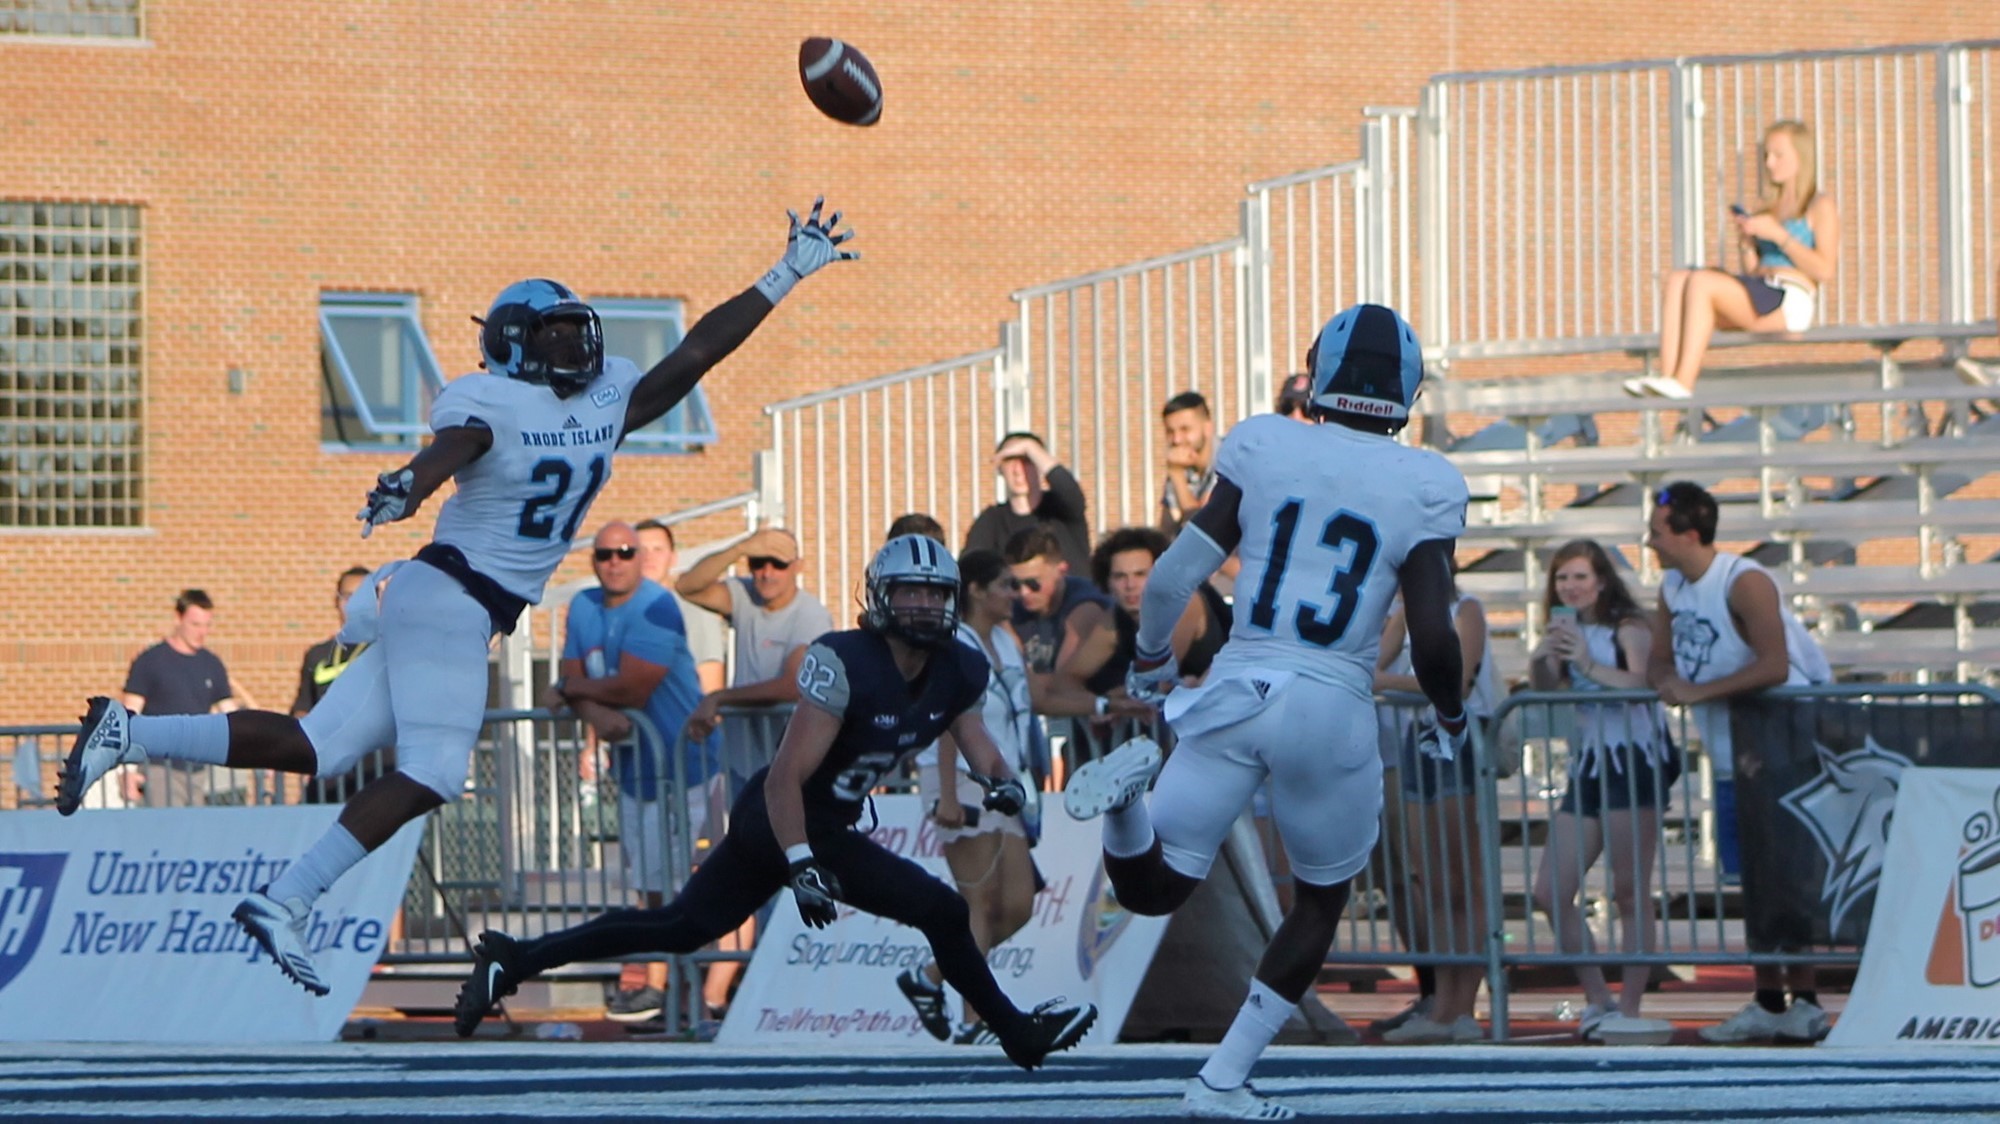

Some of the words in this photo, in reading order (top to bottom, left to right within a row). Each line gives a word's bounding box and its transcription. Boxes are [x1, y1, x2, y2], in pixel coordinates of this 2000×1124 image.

[1337, 396, 1394, 416] Riddell
[520, 431, 567, 447] RHODE
[516, 453, 606, 543] 21
[1250, 496, 1383, 648] 13
[798, 653, 837, 702] 82
[88, 710, 117, 751] adidas
[88, 849, 291, 895] University
[60, 911, 157, 955] New
